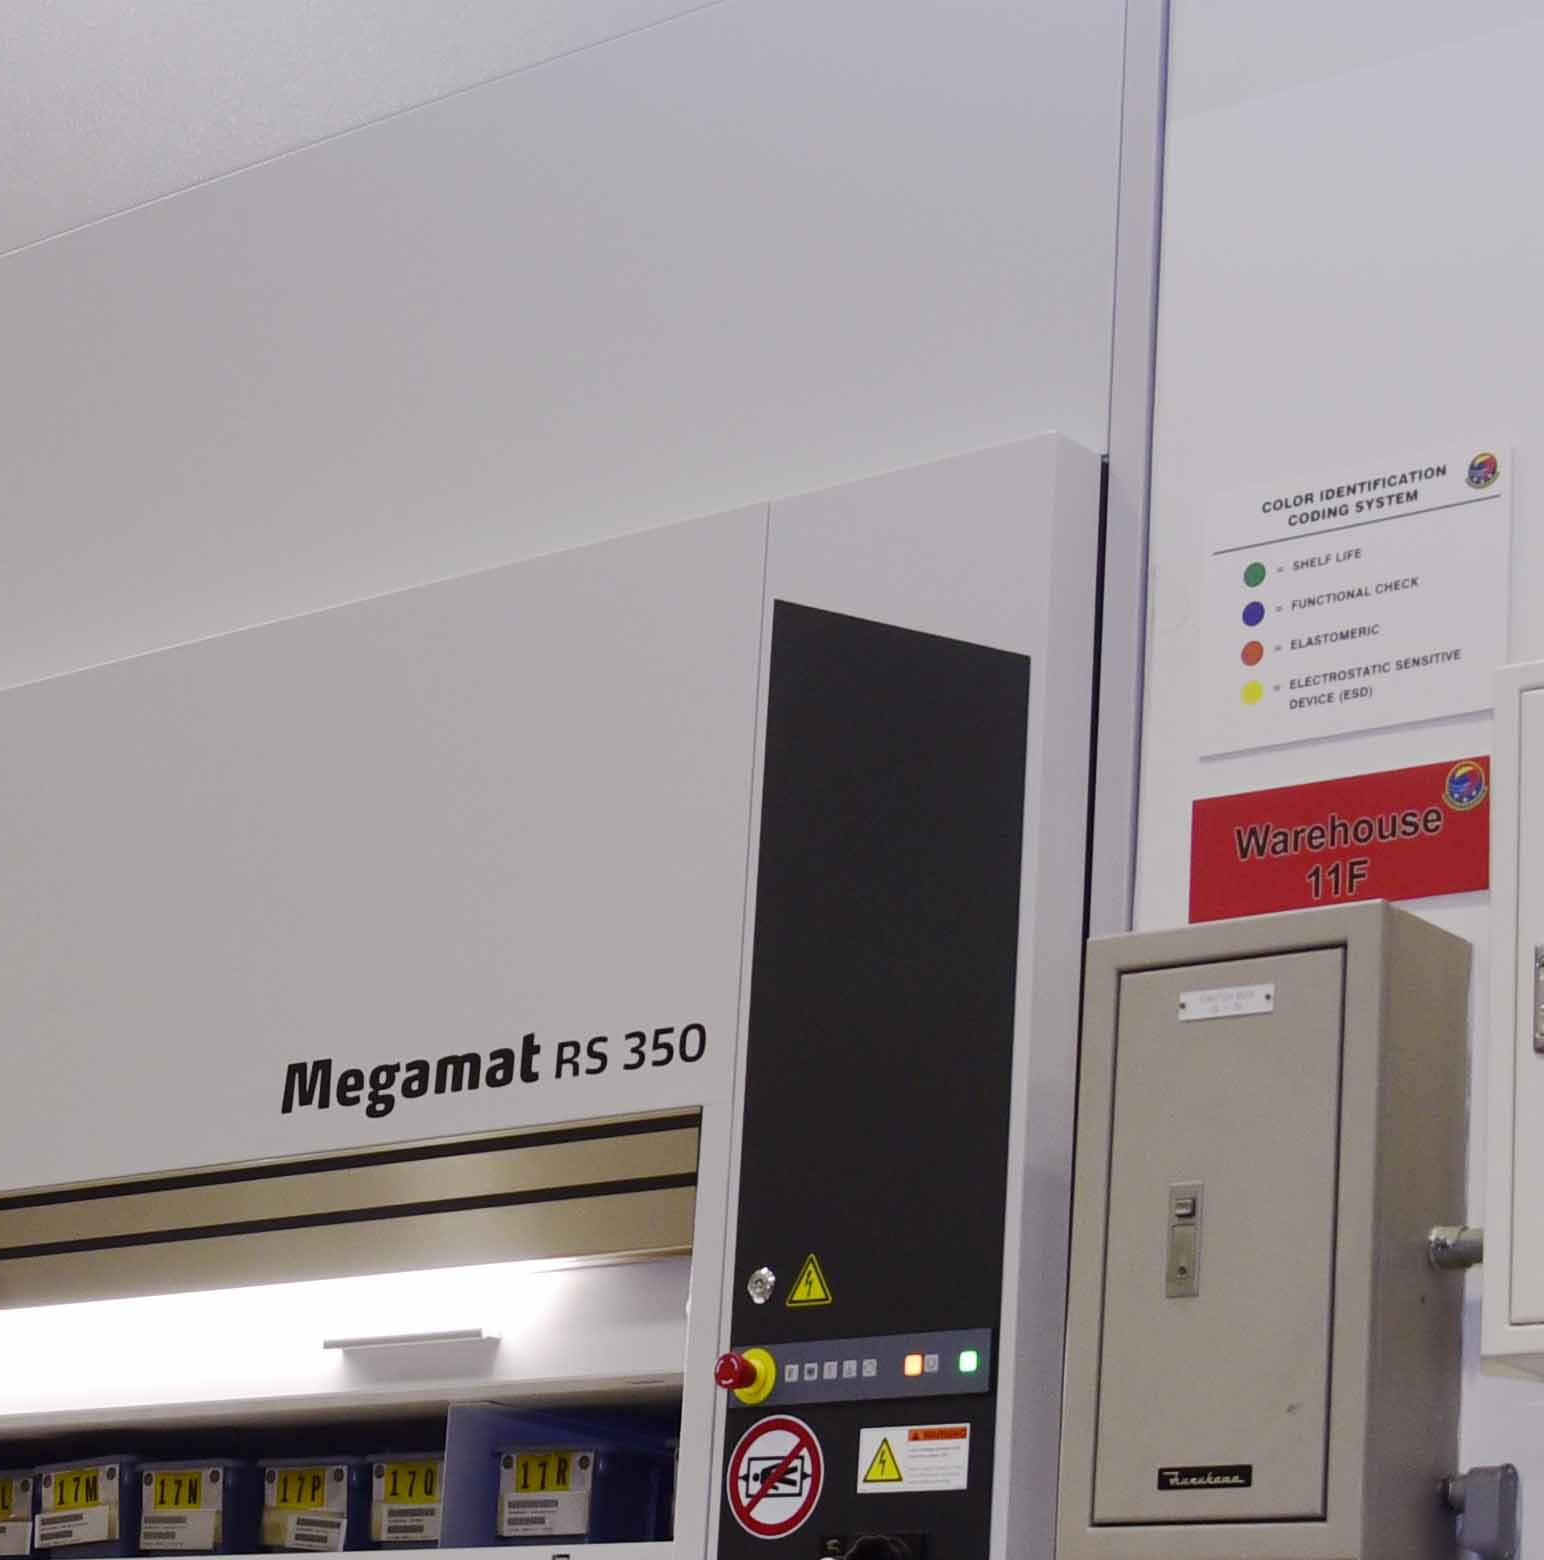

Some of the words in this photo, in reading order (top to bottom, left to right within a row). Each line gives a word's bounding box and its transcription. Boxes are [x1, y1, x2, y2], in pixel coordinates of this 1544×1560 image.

[1261, 492, 1314, 515] COLOR
[1320, 464, 1448, 502] IDENTIFICATION
[1288, 504, 1349, 527] CODING
[1355, 489, 1419, 514] SYSTEM
[1292, 553, 1335, 573] SHELF
[1337, 548, 1362, 564] LIFE
[1291, 586, 1372, 611] FUNCTIONAL
[1374, 576, 1420, 595] CHECK
[1289, 623, 1381, 651] ELASTOMERIC
[1289, 662, 1391, 690] ELECTROSTATIC
[1395, 649, 1462, 673] SENSITIVE
[1289, 691, 1335, 710] DEVICE
[1338, 686, 1373, 705] (ESD)
[1234, 806, 1443, 863] Warehouse
[1306, 858, 1369, 900] 11F
[281, 1032, 541, 1118] Megamat
[554, 1035, 609, 1079] RS
[622, 1022, 707, 1071] 350
[280, 1473, 322, 1504] 17P
[520, 1454, 570, 1490] 17R
[58, 1475, 98, 1505] 17M
[158, 1478, 198, 1506] 17N
